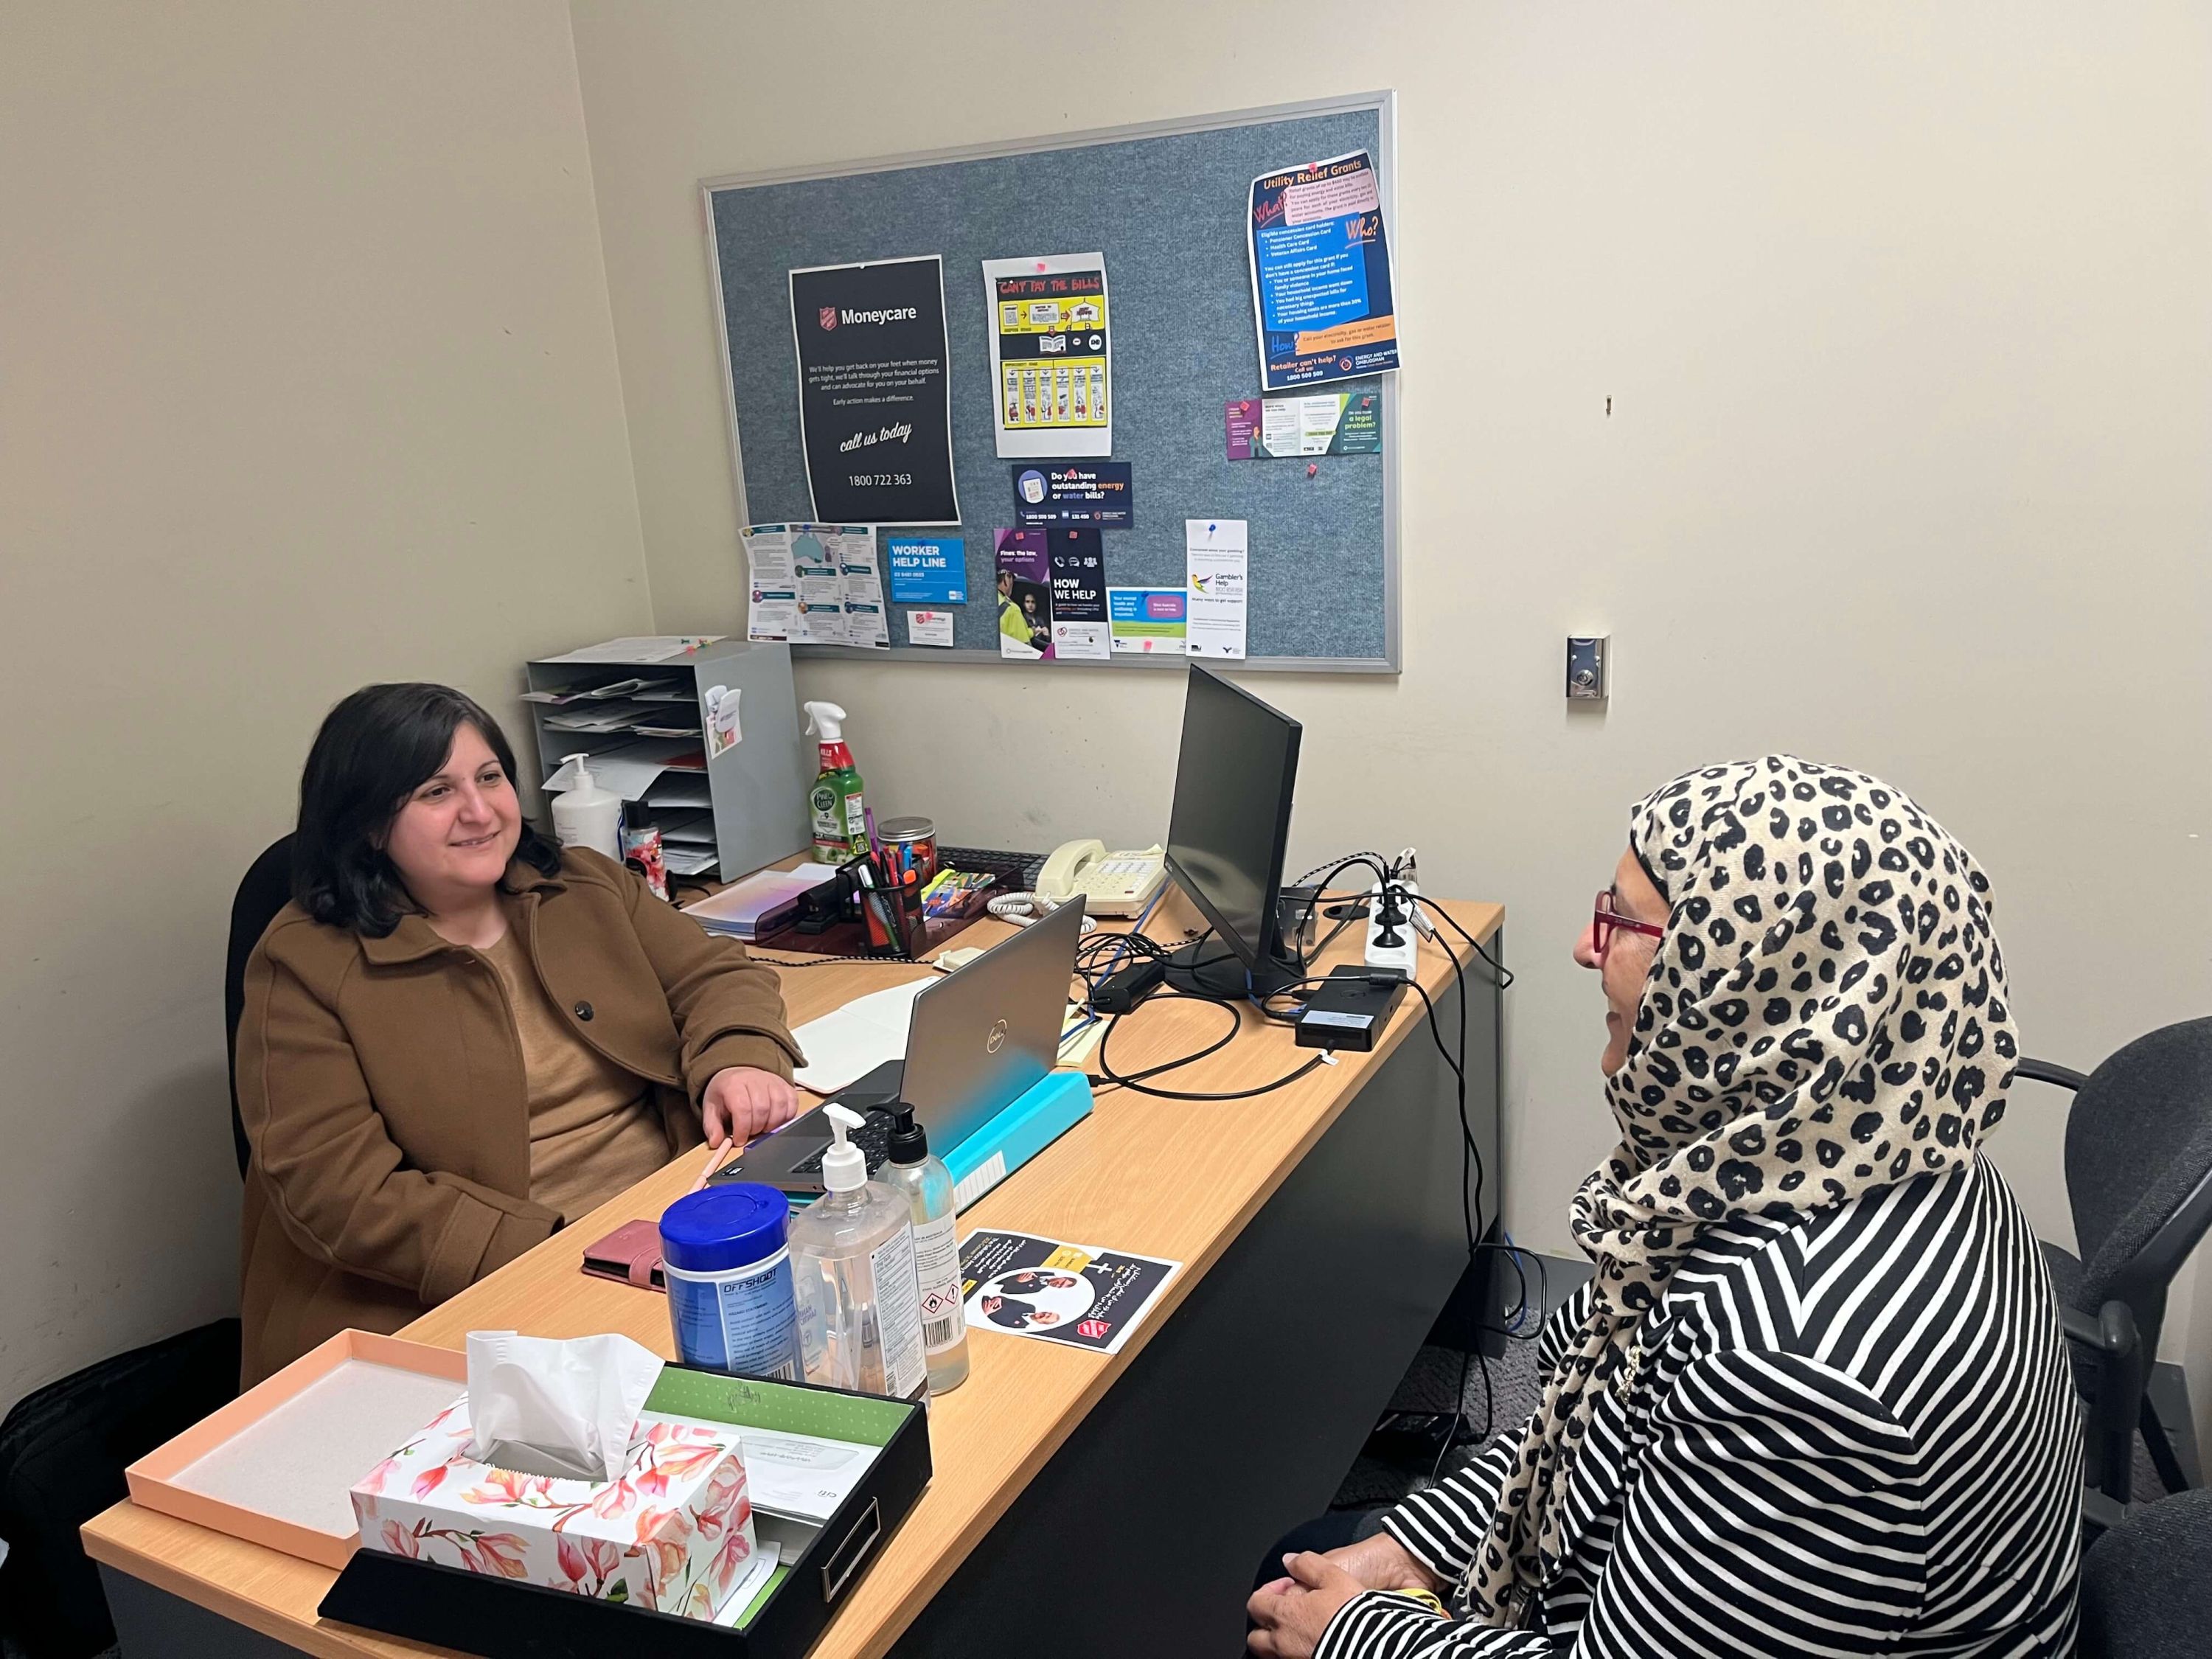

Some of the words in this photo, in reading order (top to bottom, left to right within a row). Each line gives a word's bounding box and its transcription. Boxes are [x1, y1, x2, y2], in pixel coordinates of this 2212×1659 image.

[1264, 175, 1294, 189] Utility
[1298, 169, 1327, 182] Relief
[1331, 161, 1361, 175] Grants
[1346, 216, 1378, 240] Who?
[1032, 281, 1046, 291] PAY
[1051, 279, 1067, 291] THE
[1072, 278, 1099, 291] BILLS
[842, 307, 917, 325] Moneycare
[1271, 361, 1298, 371] Retailer
[1300, 358, 1317, 366] can't
[1318, 355, 1336, 365] help?
[820, 375, 834, 383] tight,
[859, 372, 880, 380] through
[918, 368, 939, 376] options
[833, 398, 846, 406] Early
[886, 394, 914, 403] difference.
[840, 432, 862, 452] call
[864, 432, 877, 445] us
[880, 421, 912, 444] today
[849, 475, 872, 486] 1800
[874, 474, 891, 485] 722
[894, 473, 911, 485] 363
[892, 546, 939, 555] WORKER
[893, 557, 919, 566] HELP
[922, 558, 946, 567] LINE
[1054, 579, 1079, 588] HOW
[1055, 591, 1070, 599] WE
[1072, 591, 1096, 599] HELP
[816, 800, 832, 809] CLEEN
[724, 1267, 777, 1293] OFFSHOOT
[818, 1489, 837, 1498] citi
